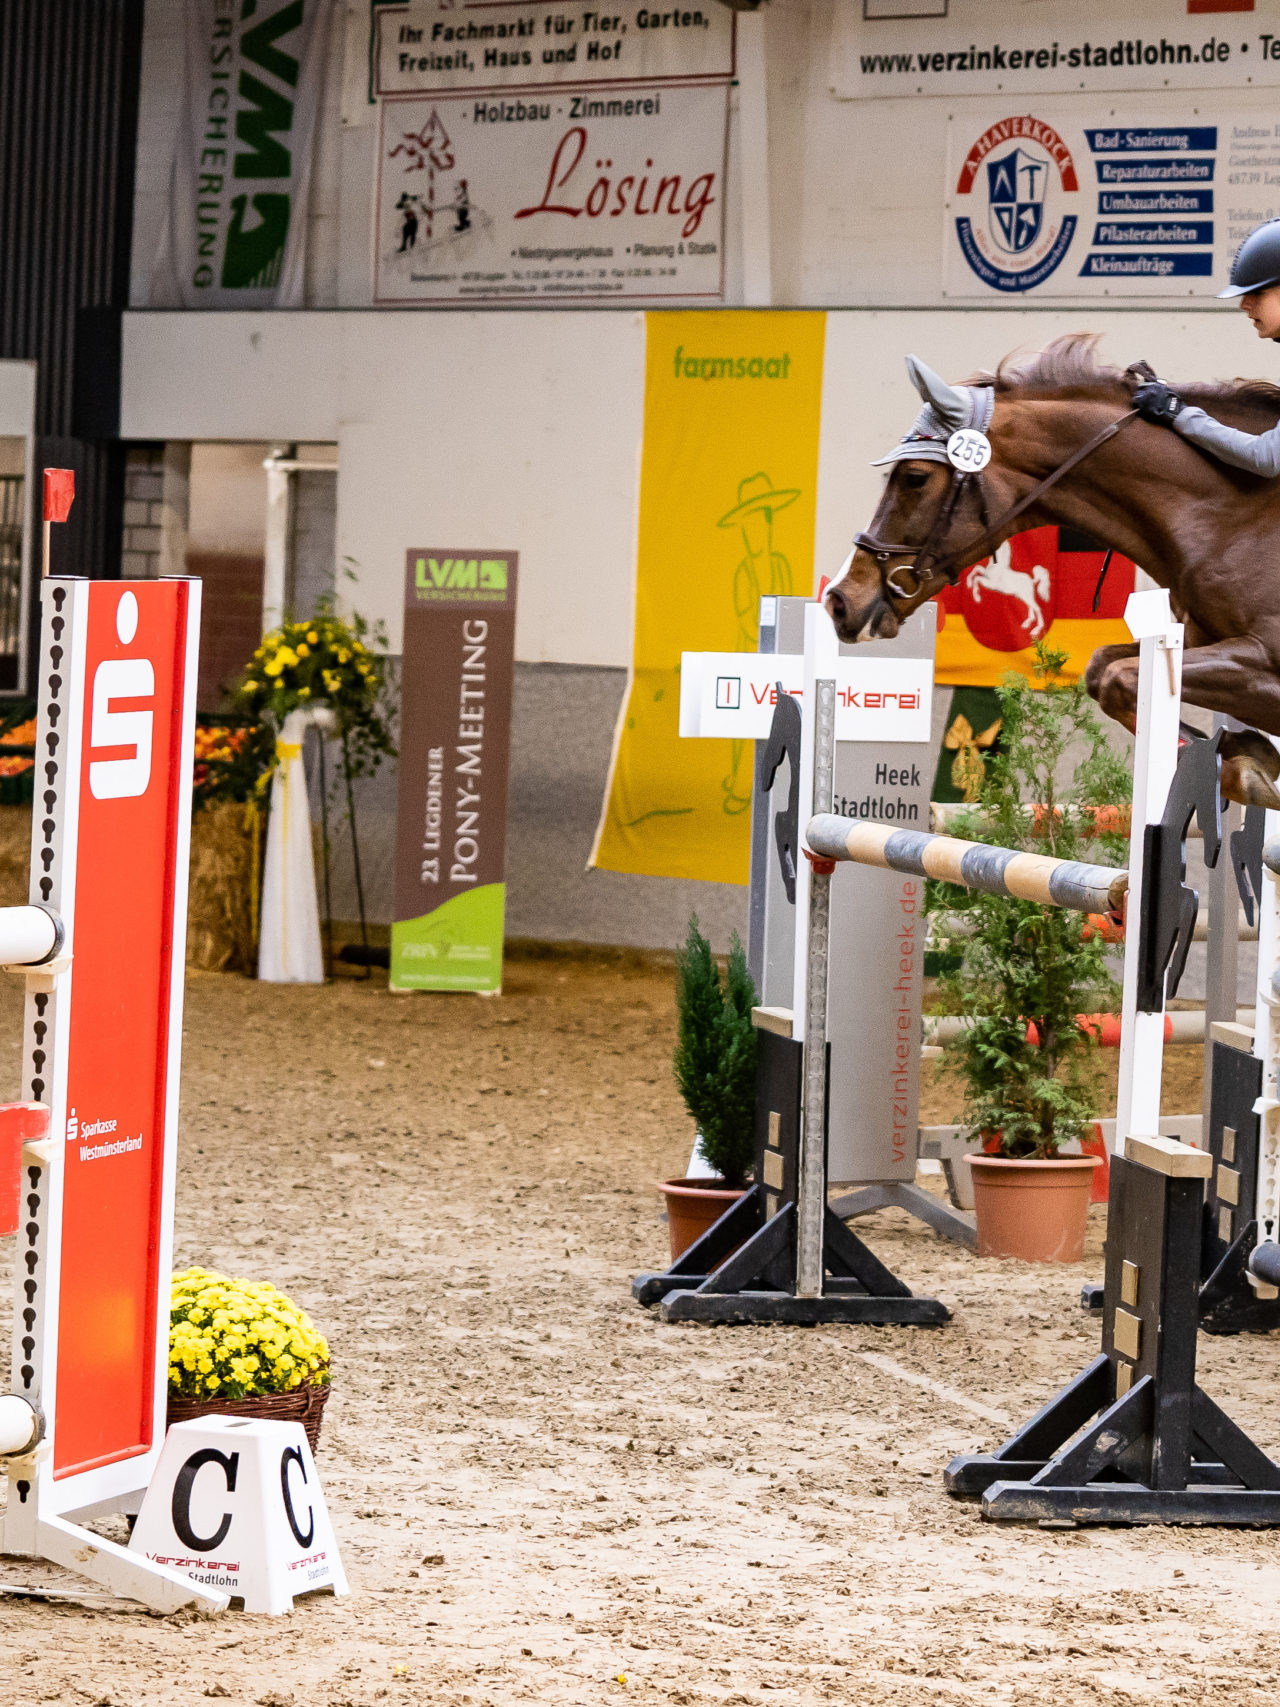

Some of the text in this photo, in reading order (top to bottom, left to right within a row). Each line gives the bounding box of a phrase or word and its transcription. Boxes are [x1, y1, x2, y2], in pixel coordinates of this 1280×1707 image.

[398, 9, 709, 43] Ihr Fachmarkt für Tier, Garten,
[399, 40, 622, 72] Freizeit, Haus und Hof
[860, 35, 1230, 74] www.verzinkerei-stadtlohn.de
[233, 0, 303, 178] VM
[474, 94, 660, 123] Holzbau Zimmerei
[514, 126, 715, 238] Lösing
[1102, 163, 1209, 181] Reparaturarbeiten
[1103, 195, 1199, 211] Umbauarbeiten
[1091, 256, 1175, 275] Kleinaufträge
[673, 345, 791, 379] farmsaat
[952, 435, 987, 465] 255
[415, 558, 477, 589] LVM
[450, 619, 489, 883] PONY-MEETING
[875, 763, 920, 786] Heek
[423, 746, 443, 850] LEGDENER
[891, 880, 916, 1165] verzinkerei-heek.de
[81, 1118, 117, 1141] Sparkasse
[80, 1133, 142, 1162] Westmünsterland
[172, 1448, 239, 1552] C
[281, 1445, 314, 1549] C
